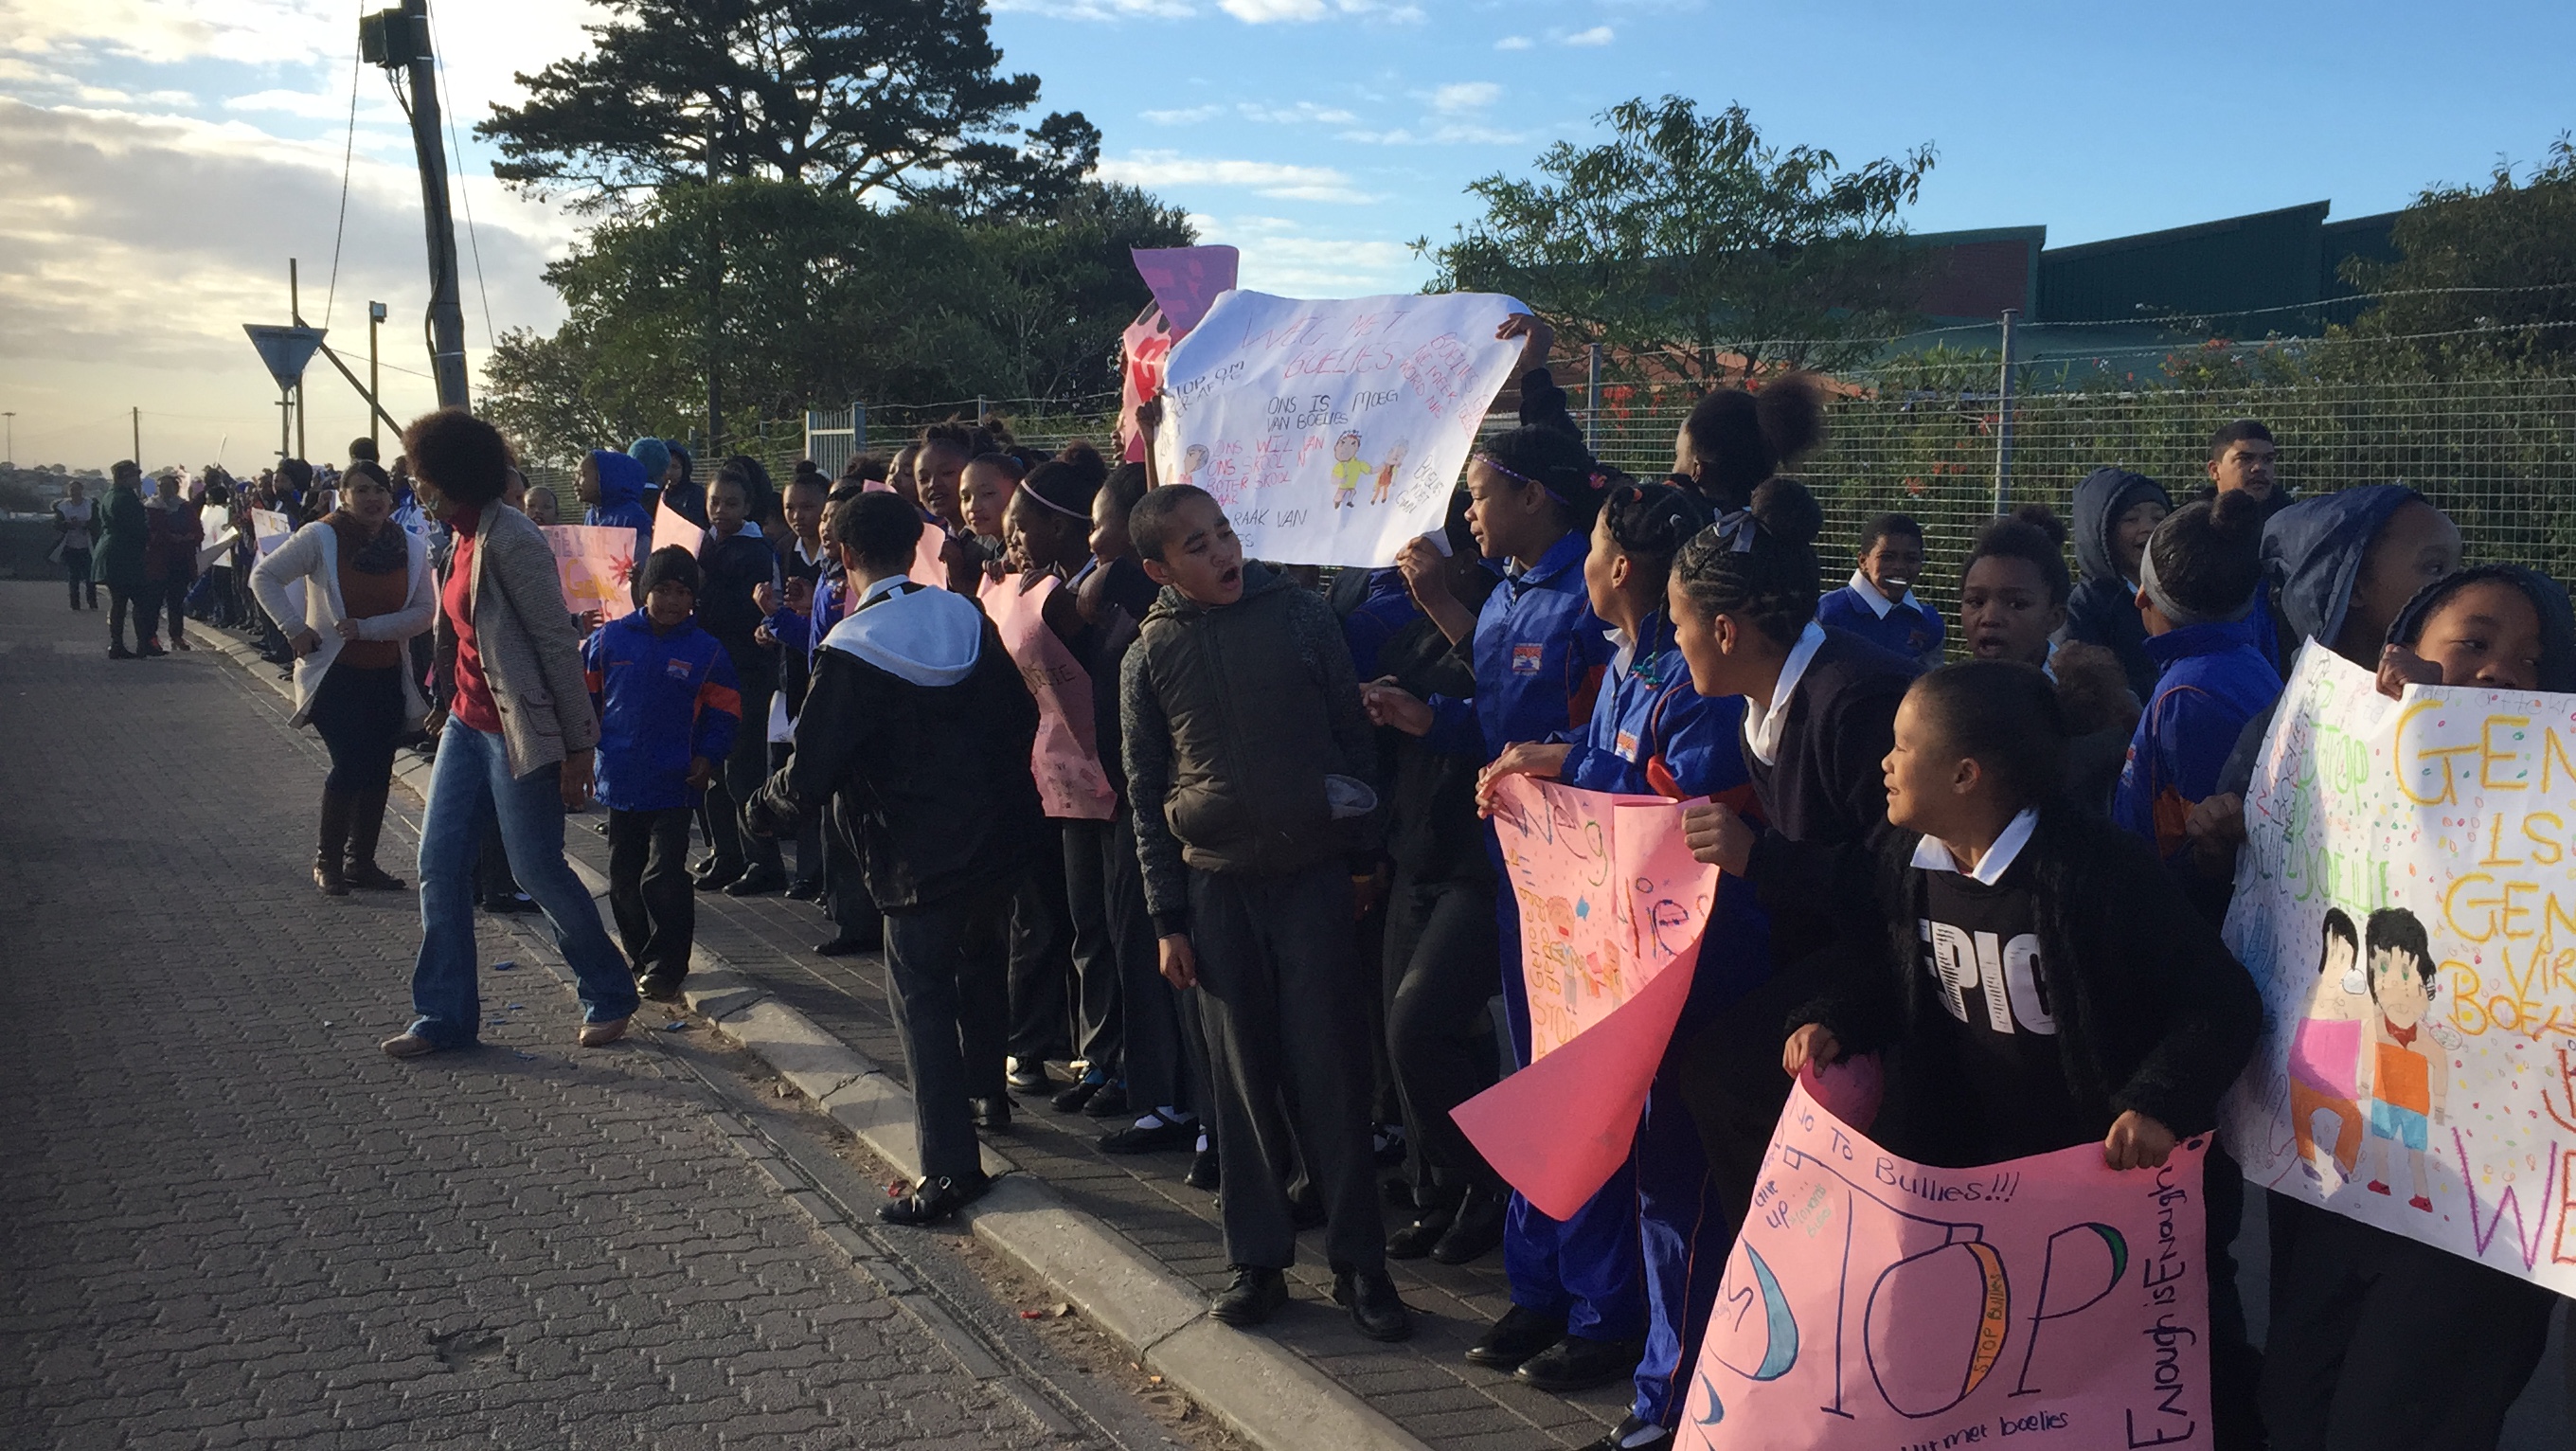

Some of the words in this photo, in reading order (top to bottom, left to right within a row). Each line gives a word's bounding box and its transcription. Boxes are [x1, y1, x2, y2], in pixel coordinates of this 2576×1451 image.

[1339, 311, 1411, 341] MET
[1215, 361, 1244, 380] OM
[1284, 341, 1402, 379] BOELIES
[1430, 331, 1479, 393] BOELIES
[1267, 396, 1297, 415] ONS
[1310, 394, 1331, 413] IS
[1351, 389, 1399, 412] MOEG
[1425, 395, 1444, 419] NIE
[1267, 417, 1290, 433] VAN
[1297, 412, 1349, 430] BOELIES
[1213, 439, 1243, 457] ONS
[1257, 436, 1293, 453] WIL
[1303, 436, 1325, 452] VAN
[1208, 458, 1236, 476] ONS
[1243, 455, 1284, 475] SKOOL
[1277, 509, 1307, 528] VAN
[2478, 811, 2565, 868] IS
[1918, 917, 2057, 1035] PIC
[1831, 1125, 1853, 1161] To
[1973, 1327, 1999, 1373] STOP
[1942, 1424, 1988, 1449] met
[1999, 1410, 2069, 1437] boelies
